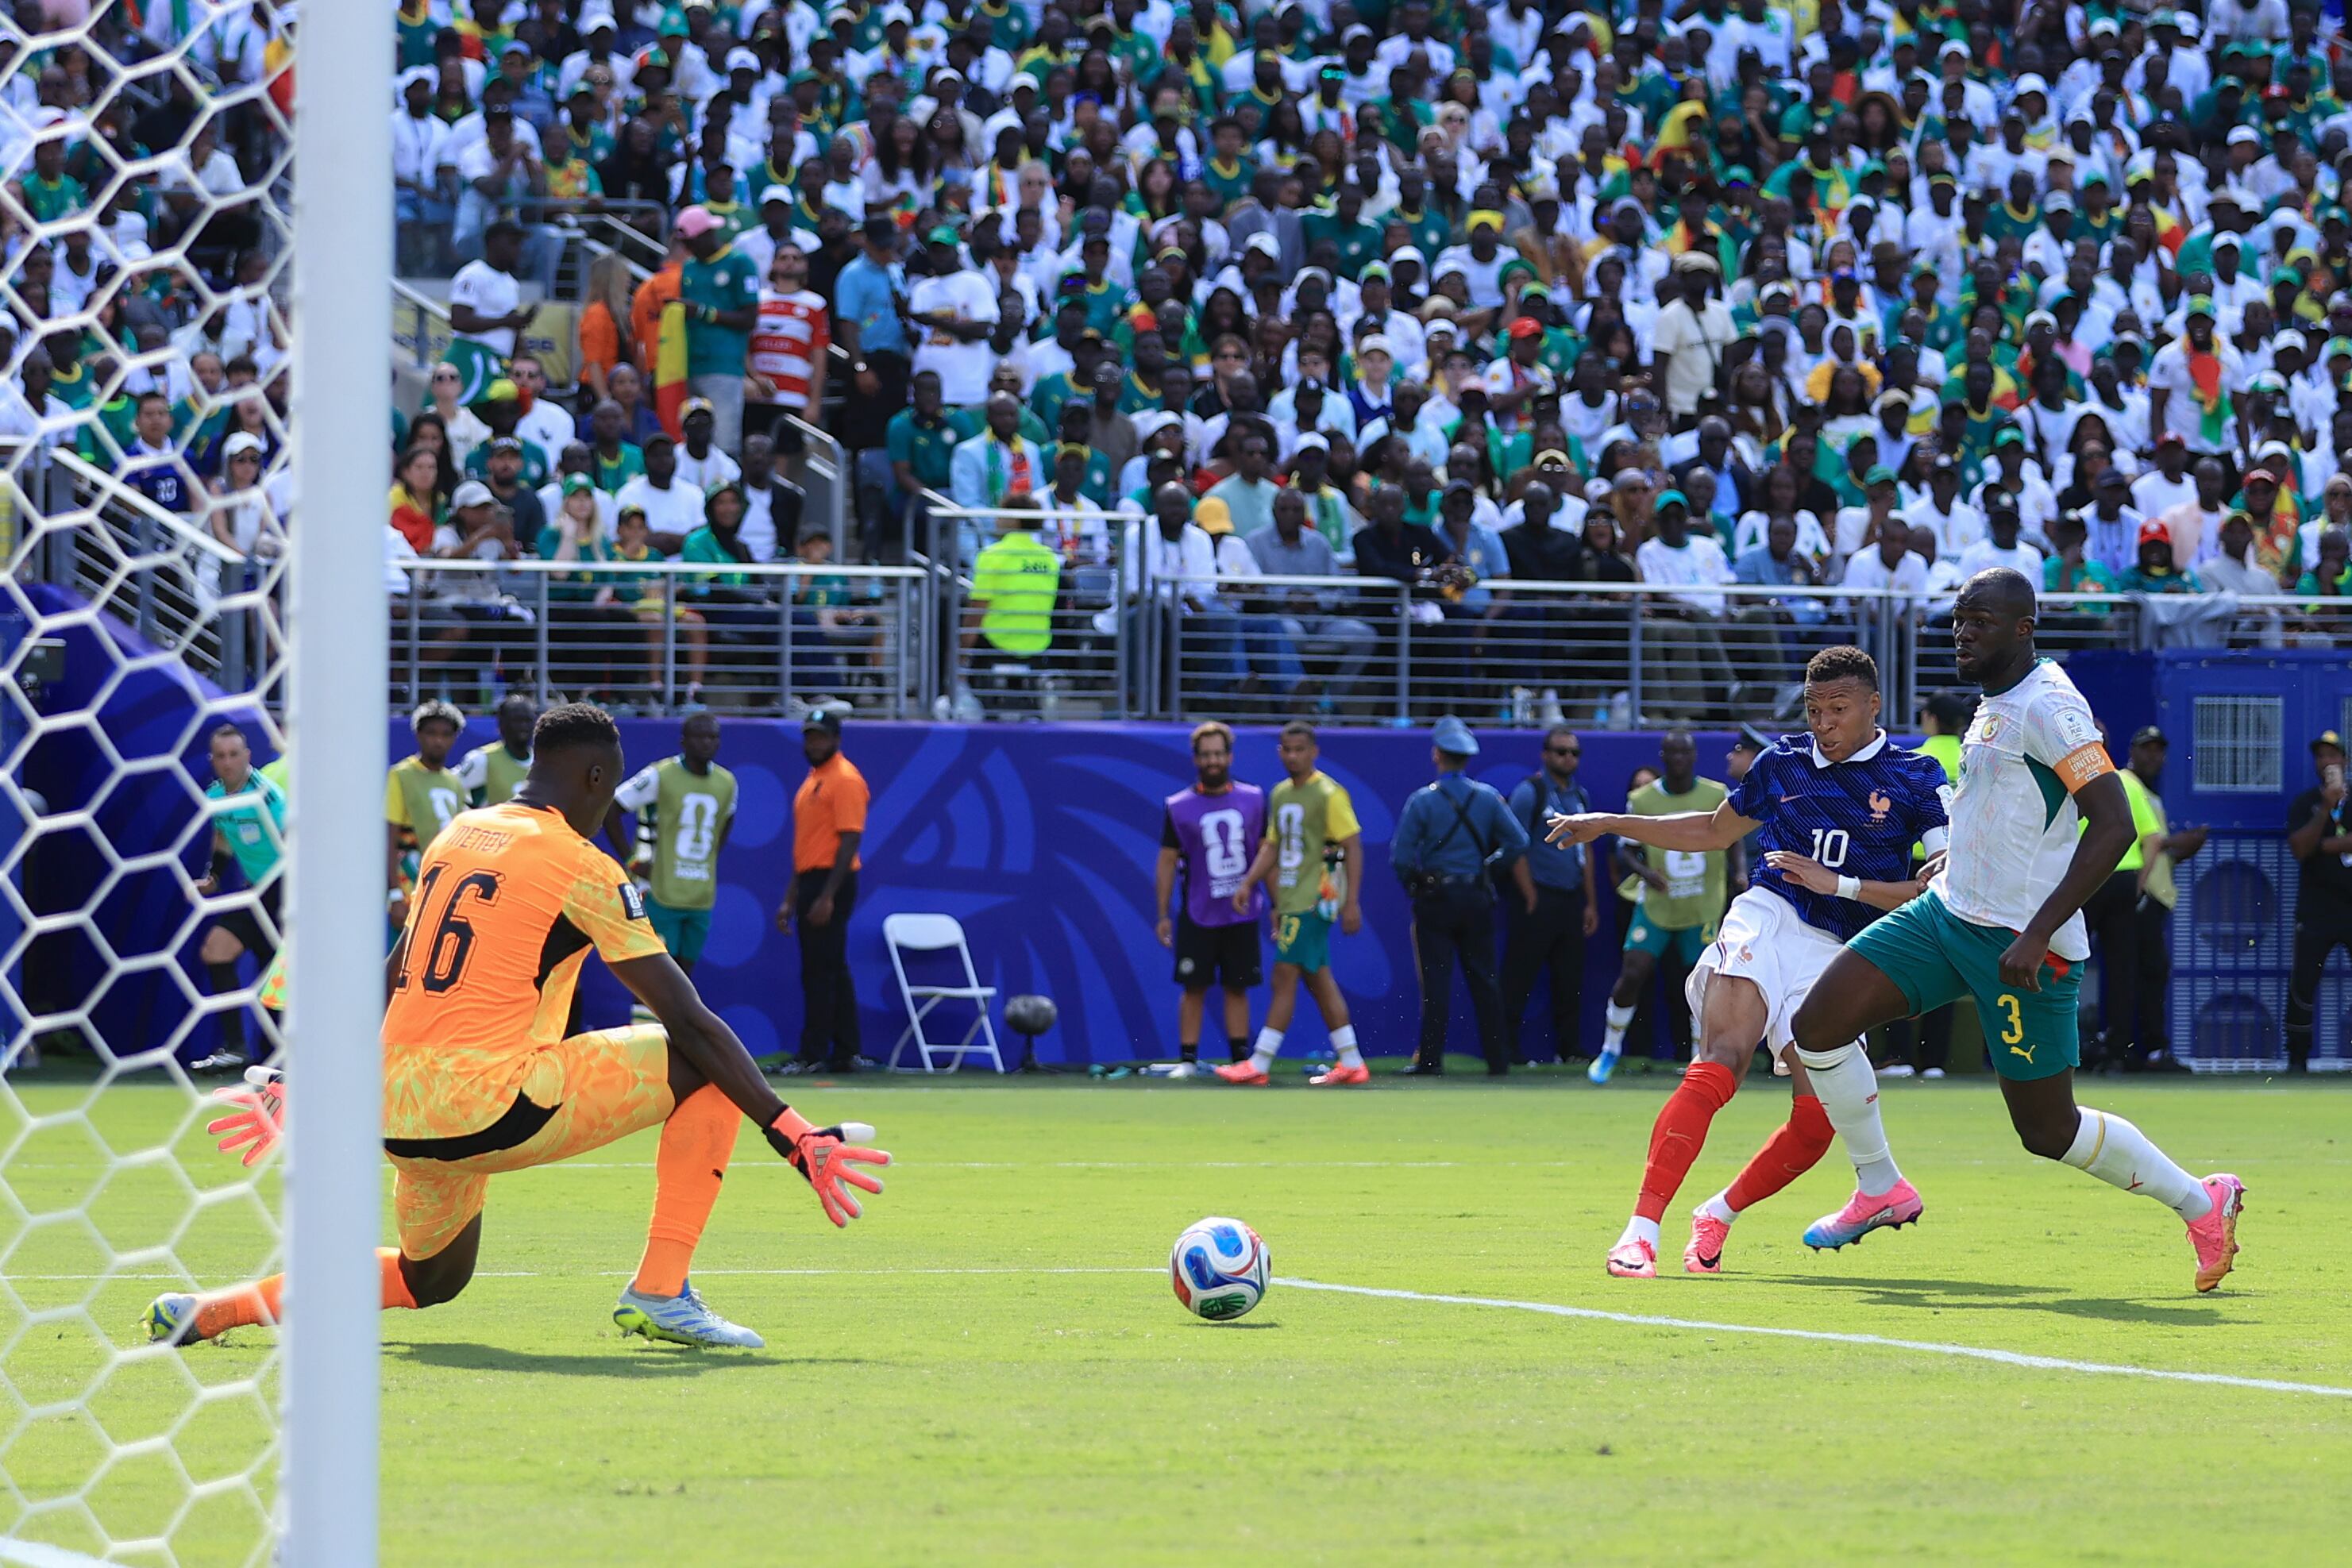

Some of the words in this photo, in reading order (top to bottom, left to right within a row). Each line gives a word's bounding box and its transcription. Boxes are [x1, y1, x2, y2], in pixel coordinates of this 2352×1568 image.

[2067, 745, 2098, 765] FOOTBALL
[2070, 751, 2102, 772] UNITES
[2085, 758, 2106, 772] World
[1811, 829, 1849, 867] 10
[396, 861, 506, 998] 16
[1997, 994, 2023, 1044] 3
